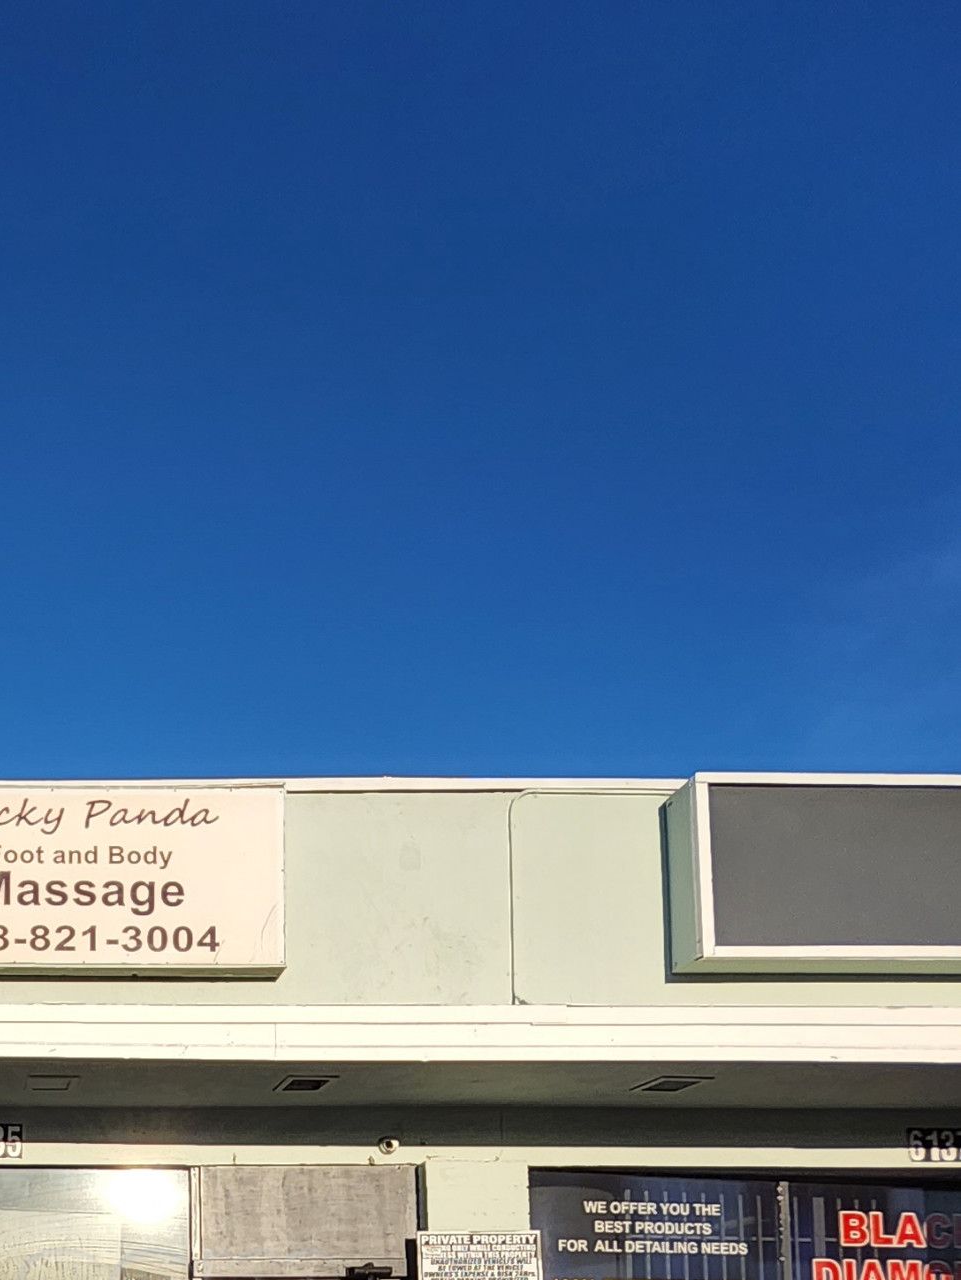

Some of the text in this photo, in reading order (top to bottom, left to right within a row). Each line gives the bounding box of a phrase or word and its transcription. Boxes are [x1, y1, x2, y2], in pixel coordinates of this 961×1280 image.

[84, 798, 219, 829] Panda
[53, 846, 98, 864] and
[108, 846, 172, 869] Body
[584, 1201, 721, 1216] WE OFFER YOU THE
[594, 1221, 712, 1235] BEST PRODUCTS
[422, 1235, 536, 1244] PRIVATE PROPERTY
[558, 1239, 748, 1255] FOR ALL DETAILING NEEDS
